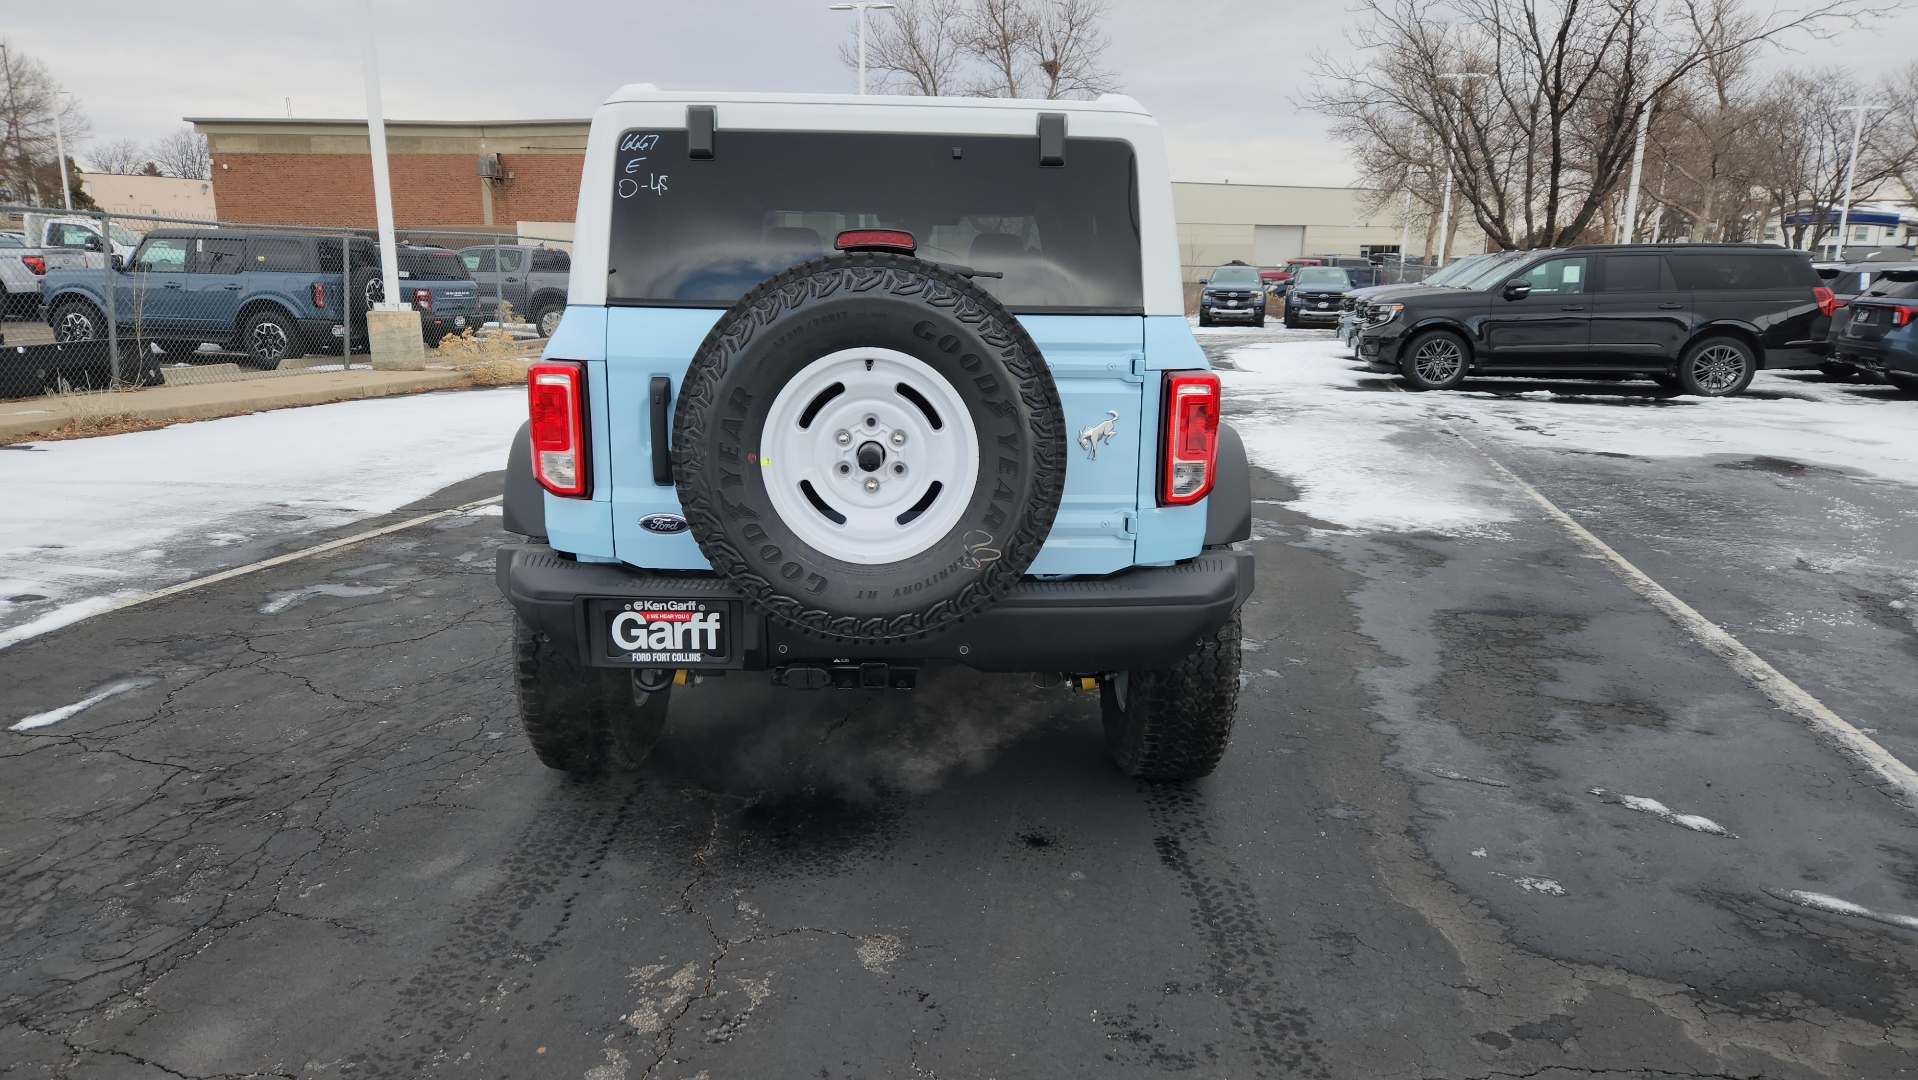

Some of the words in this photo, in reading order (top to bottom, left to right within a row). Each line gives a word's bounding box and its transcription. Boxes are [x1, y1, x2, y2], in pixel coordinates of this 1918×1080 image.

[625, 156, 647, 173] E
[650, 517, 679, 530] Ford
[644, 600, 667, 611] Ken
[667, 600, 697, 611] Garff
[611, 611, 721, 651] Garff
[632, 652, 651, 662] FORD
[652, 652, 671, 662] FORT
[672, 652, 702, 662] COLLINS
